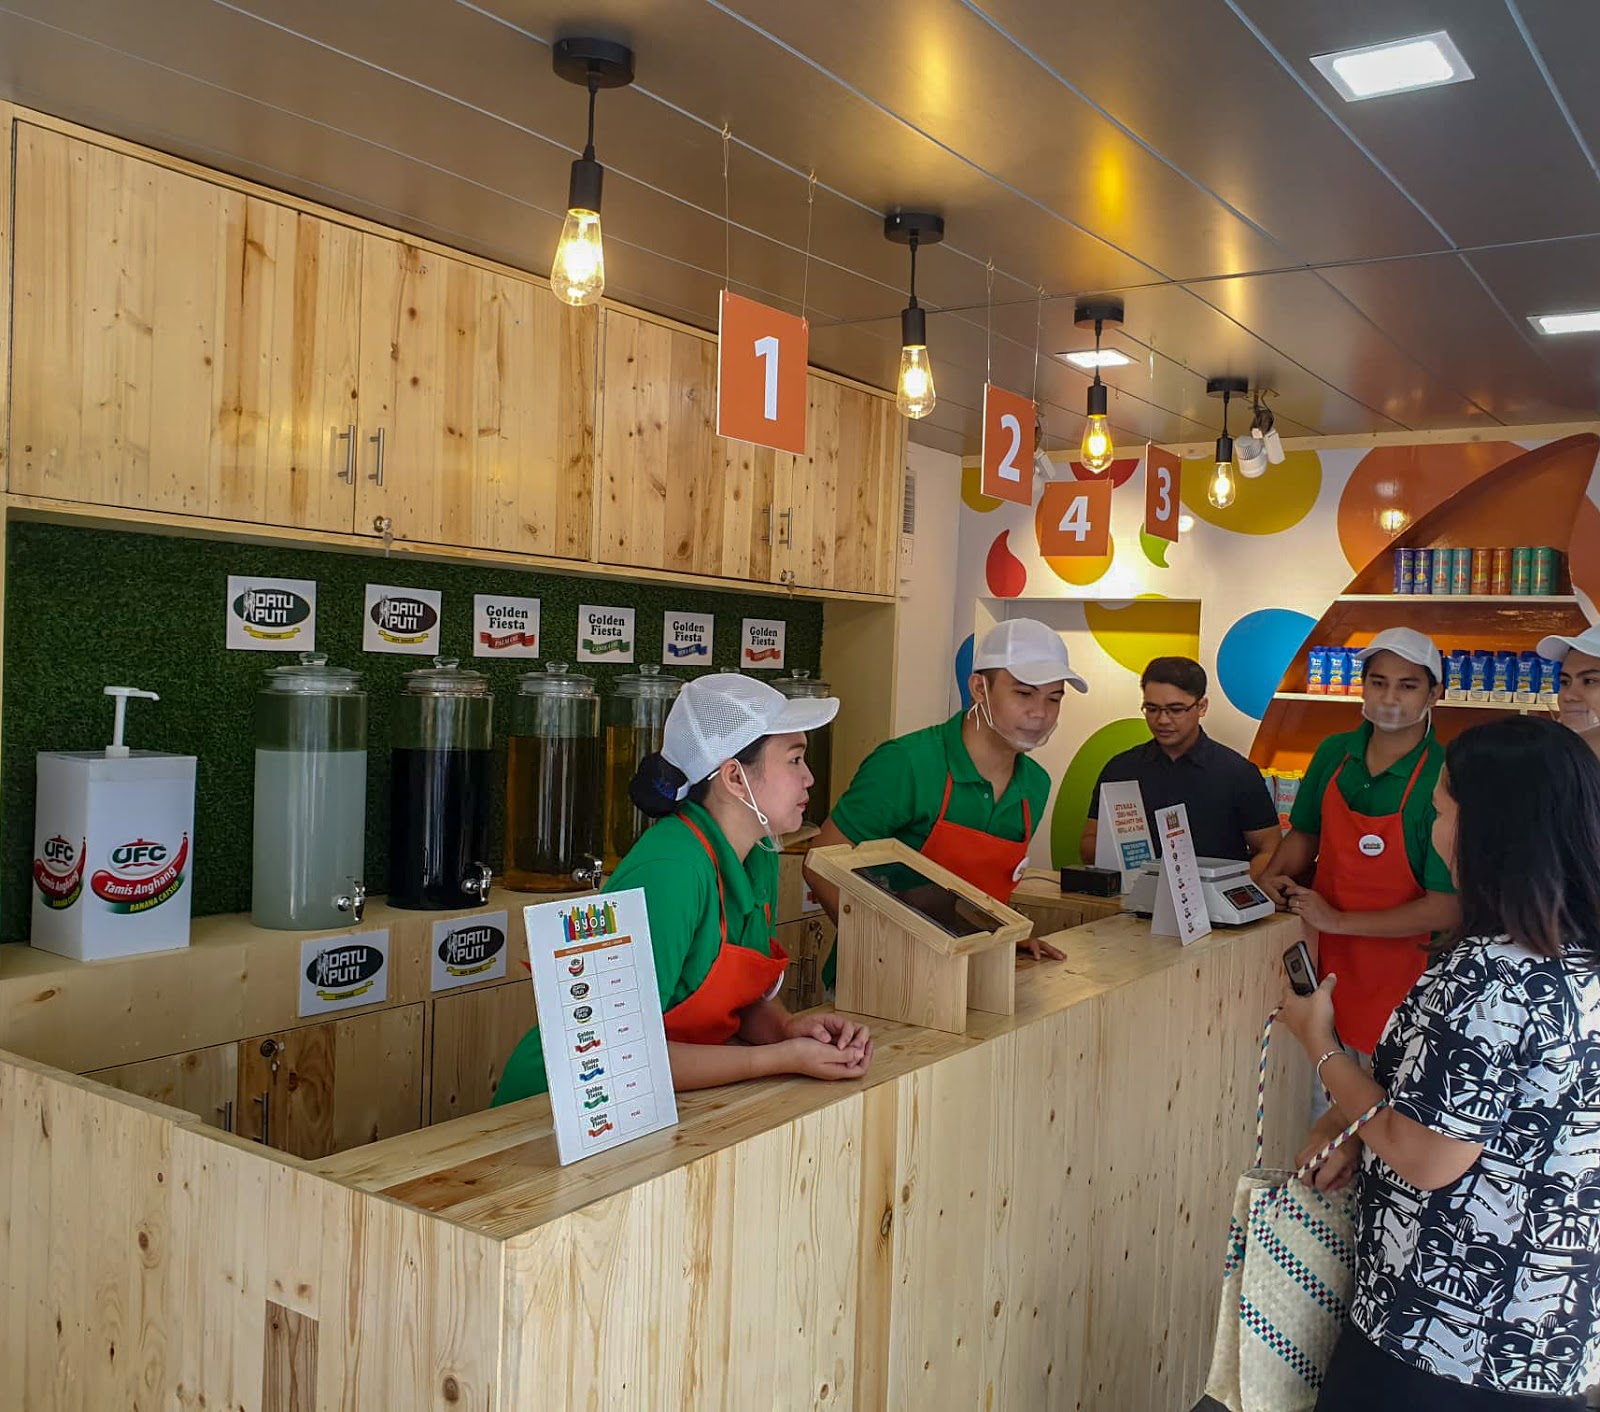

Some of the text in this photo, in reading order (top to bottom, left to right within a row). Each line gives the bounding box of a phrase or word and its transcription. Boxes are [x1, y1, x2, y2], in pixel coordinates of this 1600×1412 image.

[753, 335, 780, 421] 1
[997, 414, 1022, 483] 2
[1156, 467, 1172, 522] 3
[1058, 496, 1092, 541] 4
[255, 593, 294, 609] DATU
[255, 609, 287, 623] PUTI
[389, 602, 424, 617] DATU
[486, 605, 528, 619] Golden
[389, 616, 417, 630] PUTI
[489, 617, 525, 630] Fiesta
[588, 613, 625, 627] Golden
[673, 620, 705, 633] Golden
[590, 625, 622, 636] Fiesta
[674, 631, 702, 642] Fiesta
[749, 626, 778, 637] Golden
[751, 636, 775, 646] Fiesta
[44, 841, 74, 861] UFC
[112, 845, 167, 864] UFC
[104, 866, 178, 895] Tamis Anghang
[129, 880, 180, 912] BANANA CATSUP
[574, 915, 606, 931] BYOB
[457, 929, 491, 946] DATU
[328, 949, 368, 969] DATU
[456, 945, 485, 962] PUTI
[328, 966, 360, 985] PUTI
